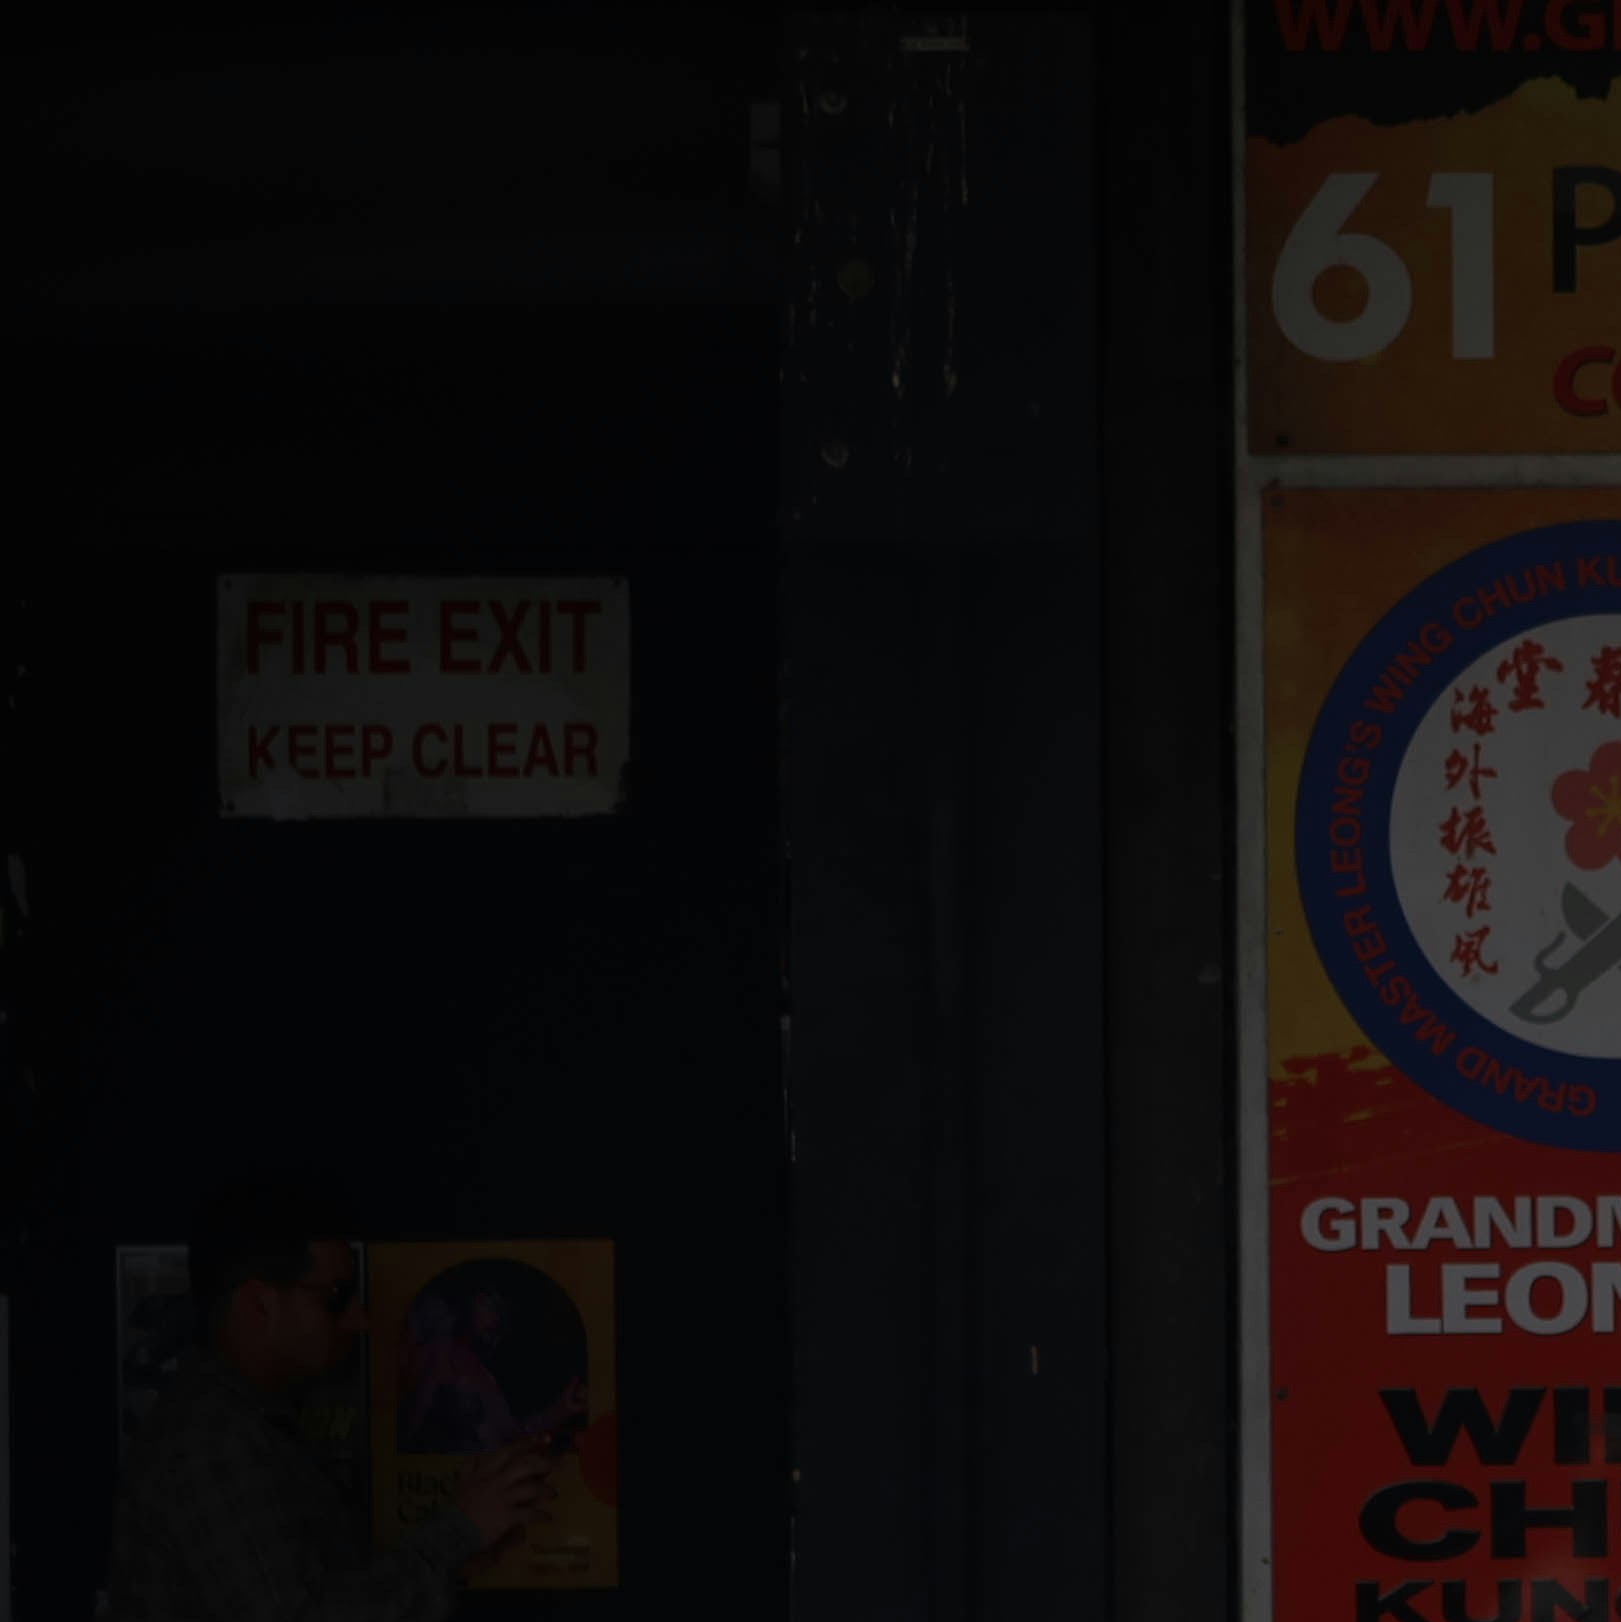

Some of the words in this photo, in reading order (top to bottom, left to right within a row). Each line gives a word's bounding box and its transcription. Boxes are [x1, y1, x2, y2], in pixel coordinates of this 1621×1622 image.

[1272, 171, 1495, 362] 61
[1449, 559, 1568, 628] CHUN
[245, 599, 411, 675] FIRE
[439, 599, 602, 674] EXIT
[1362, 619, 1454, 714] WING
[247, 724, 393, 780] KEEP
[412, 722, 600, 779] CLEAR
[1326, 718, 1383, 897] LEONG'S
[1342, 902, 1458, 1056] MASTER
[1455, 1042, 1598, 1118] GRAND
